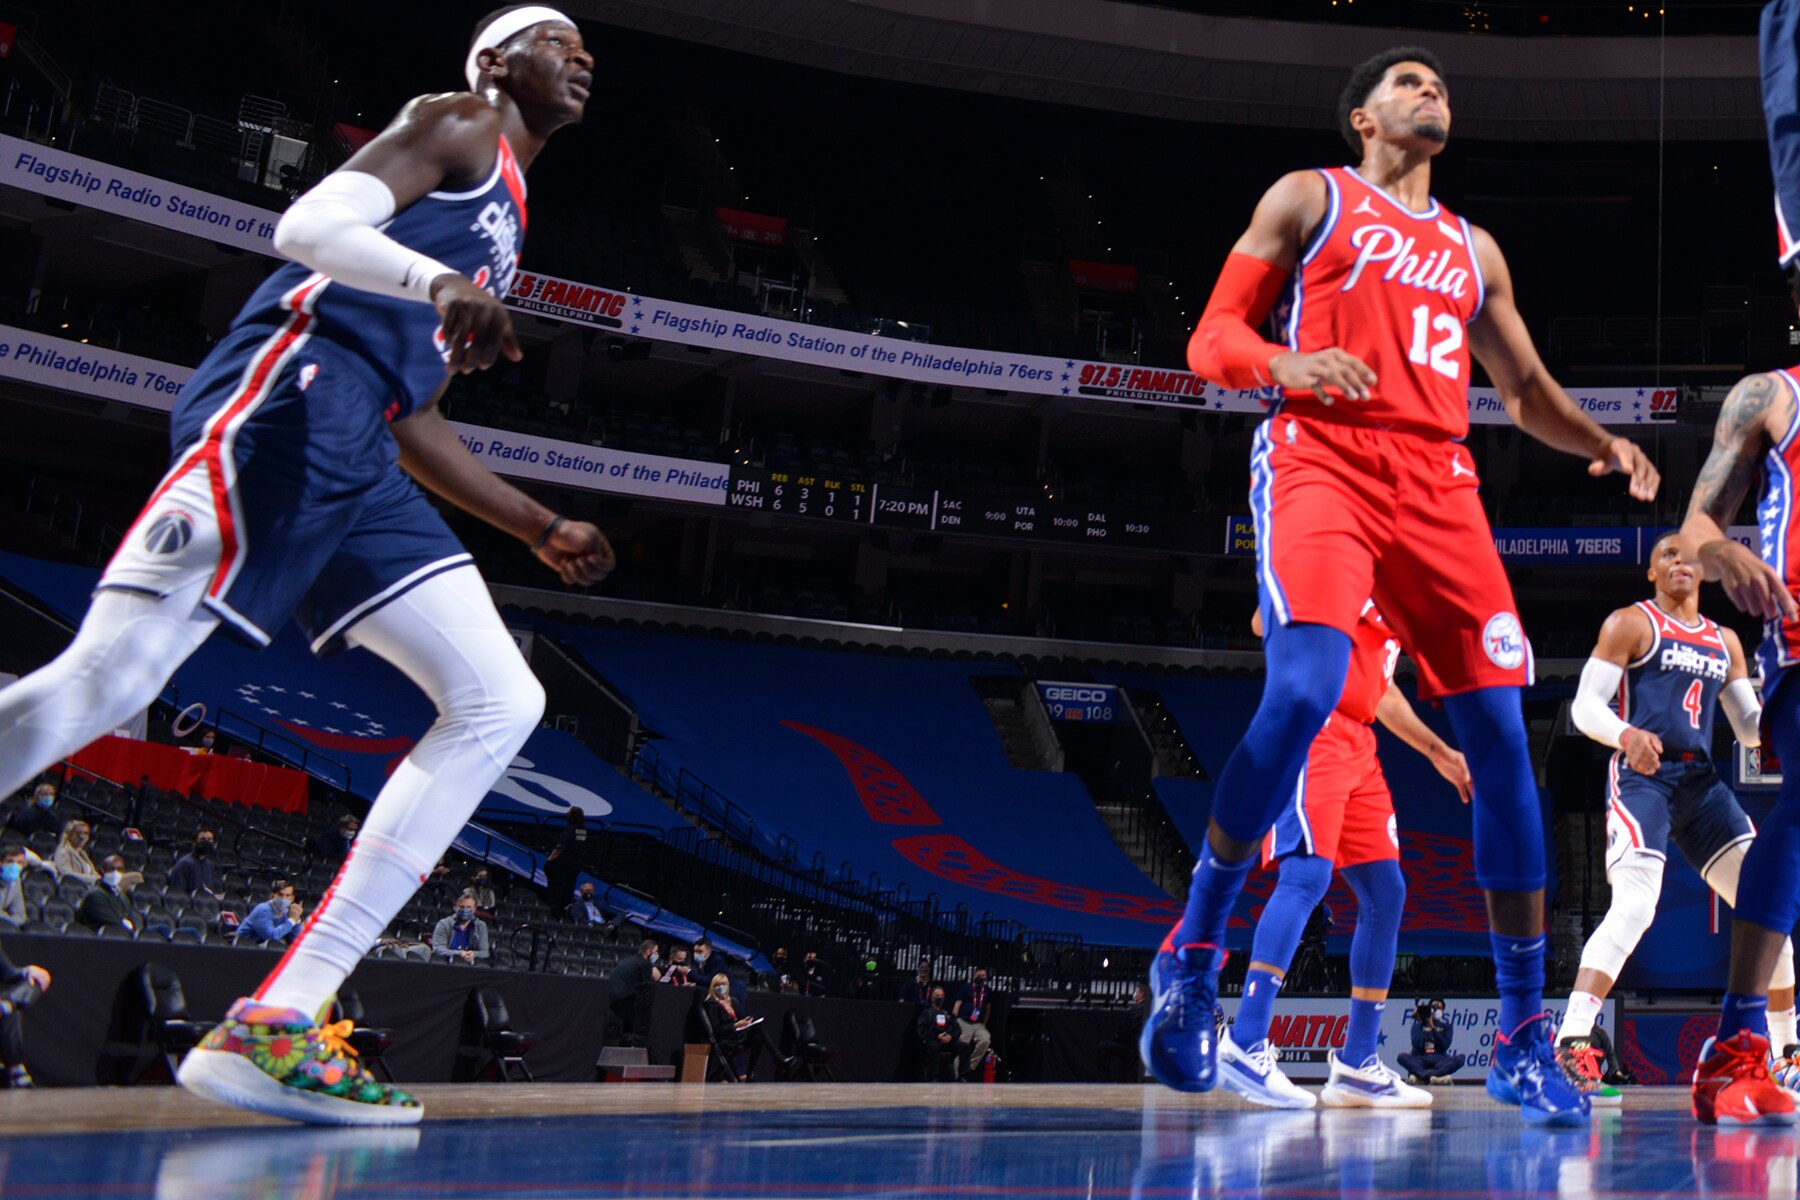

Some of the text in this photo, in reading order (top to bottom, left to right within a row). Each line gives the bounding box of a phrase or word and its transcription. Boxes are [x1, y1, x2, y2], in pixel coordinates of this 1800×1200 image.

[15, 152, 256, 233] Flagship Radio Station of
[1340, 224, 1469, 299] Phila
[517, 299, 595, 322] PHILADELPHIA
[540, 279, 626, 317] FANATIC
[652, 309, 1054, 382] Flagship Radio Station the Philadelphia 76ers
[1409, 304, 1464, 380] 12
[14, 342, 139, 386] Philadelphia
[1078, 363, 1121, 388] 97.5
[1106, 388, 1179, 402] PHILADELPHIA
[1579, 396, 1622, 413] 76ers
[488, 441, 540, 463] Radio
[544, 450, 605, 475] Station
[633, 463, 661, 483] the
[731, 493, 763, 509] WSH
[908, 502, 929, 516] PM
[1575, 537, 1621, 555] 76ERS
[1046, 687, 1106, 703] GEICO
[1682, 678, 1703, 731] 4
[1086, 705, 1112, 720] 108
